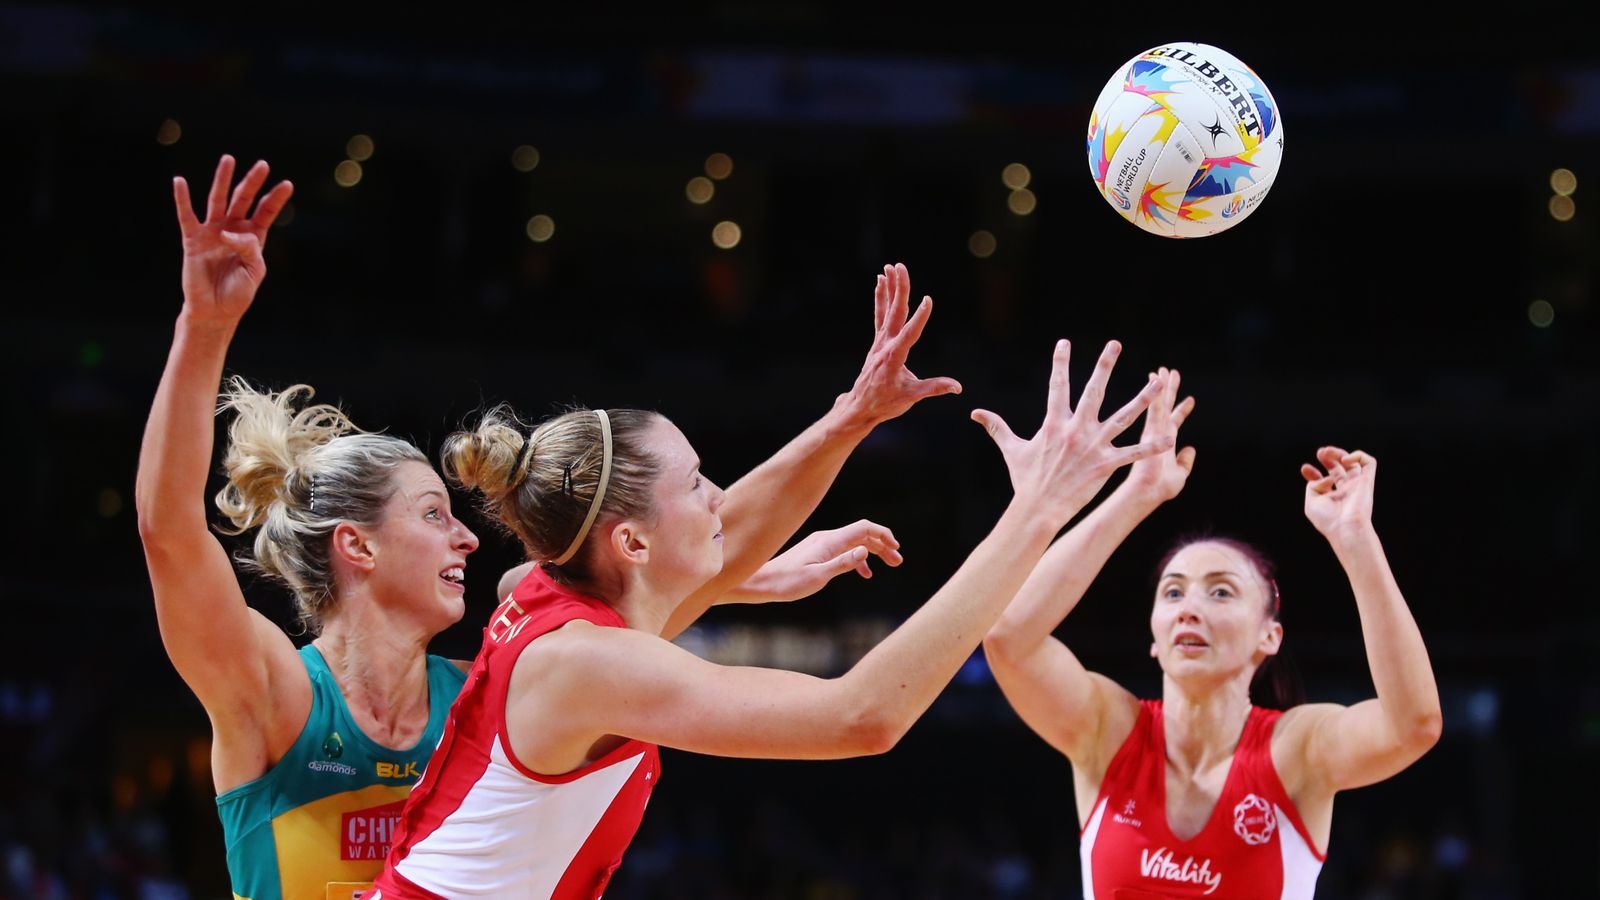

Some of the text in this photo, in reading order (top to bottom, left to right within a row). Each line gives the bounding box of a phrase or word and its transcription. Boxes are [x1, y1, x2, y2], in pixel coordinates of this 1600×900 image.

[1147, 47, 1262, 136] GILBERT
[1116, 157, 1134, 188] NETBALL
[1124, 148, 1147, 192] WORLD CUP
[308, 760, 357, 776] diamonds
[376, 761, 421, 778] BLK
[349, 816, 402, 844] CHI
[1141, 847, 1222, 895] Vitality
